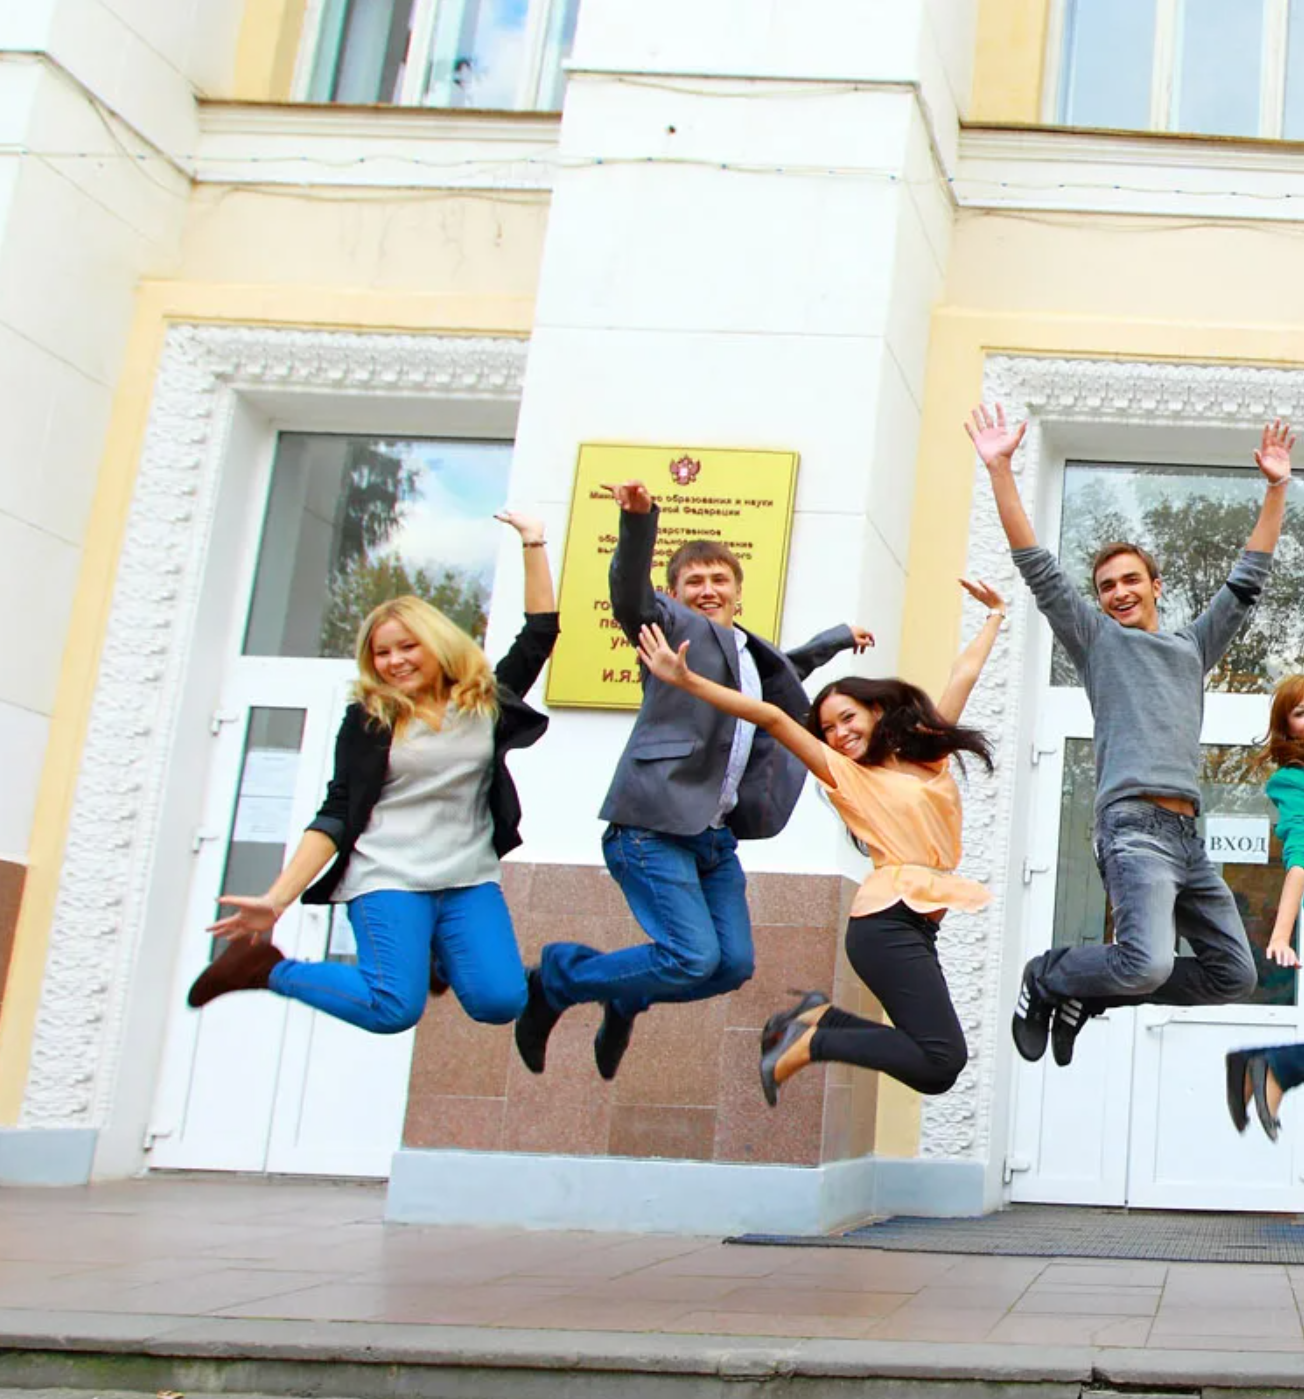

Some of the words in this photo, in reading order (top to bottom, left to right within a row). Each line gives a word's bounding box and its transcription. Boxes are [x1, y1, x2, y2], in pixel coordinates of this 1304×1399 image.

[666, 494, 732, 505] образования
[744, 499, 774, 508] науки
[683, 506, 741, 516] Федерации
[1210, 835, 1267, 853] ВХОД
